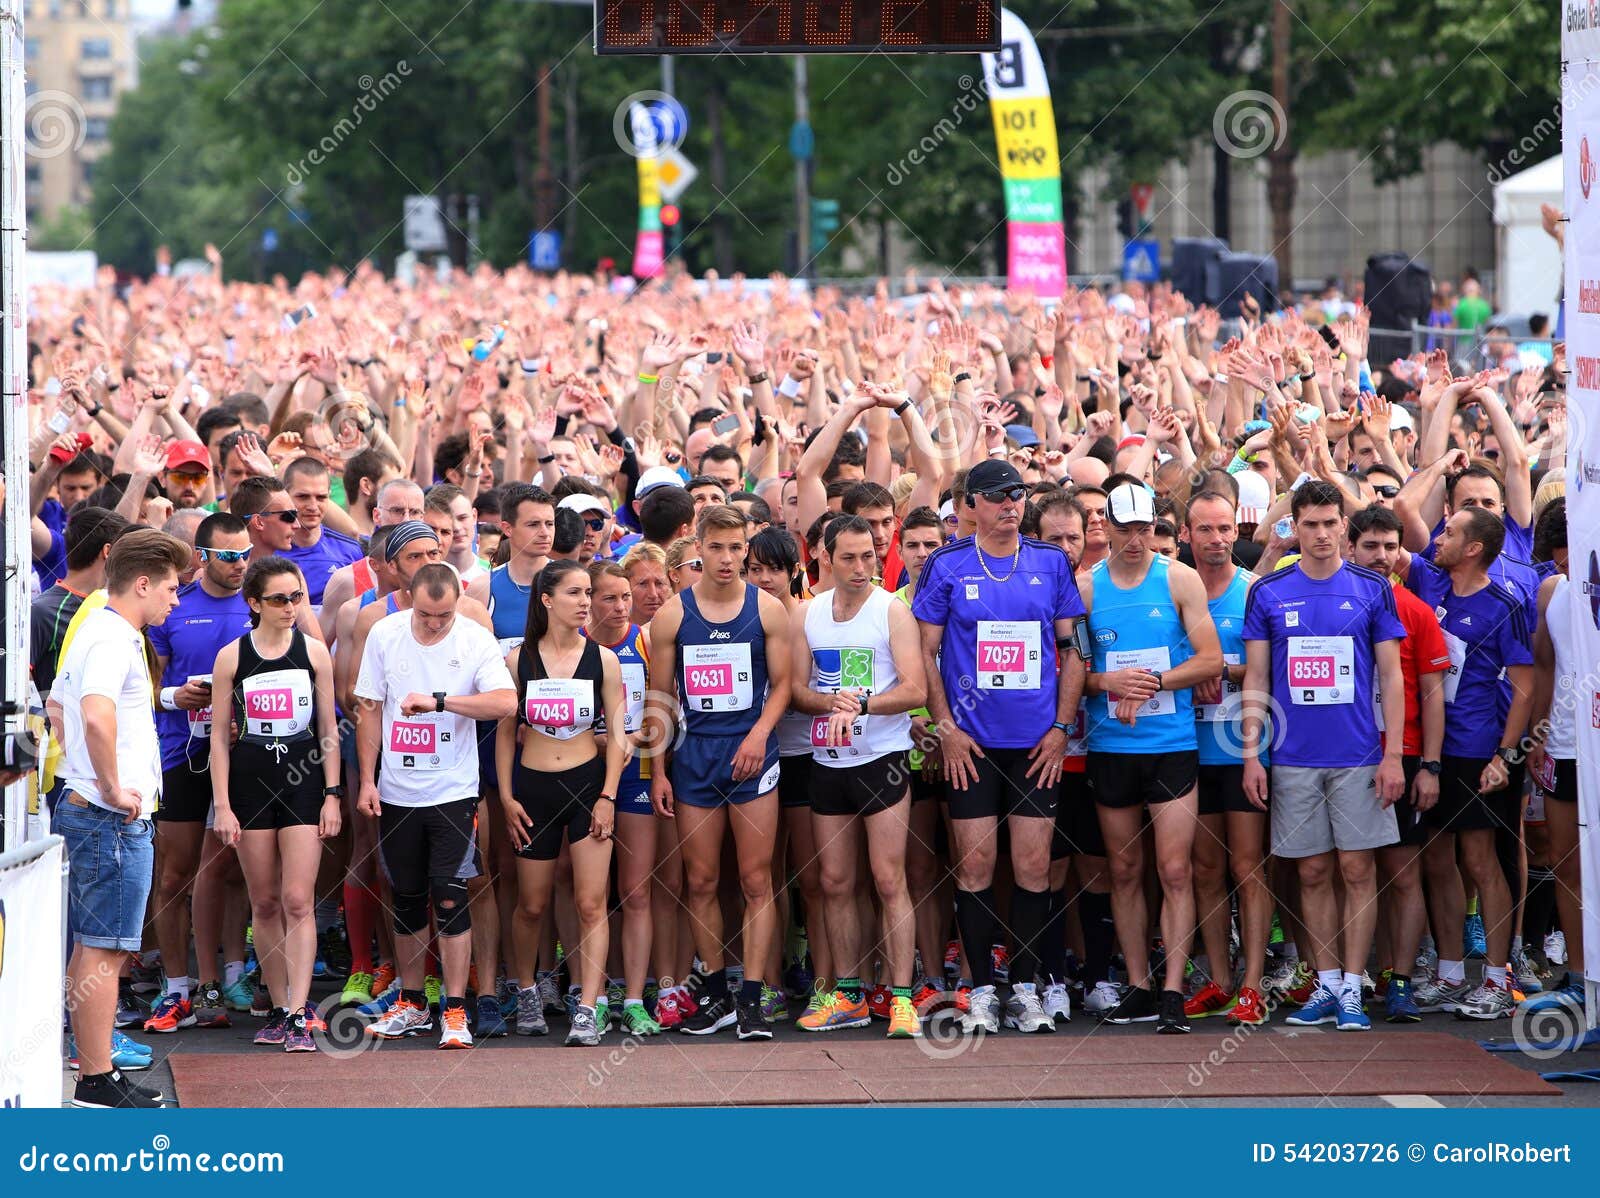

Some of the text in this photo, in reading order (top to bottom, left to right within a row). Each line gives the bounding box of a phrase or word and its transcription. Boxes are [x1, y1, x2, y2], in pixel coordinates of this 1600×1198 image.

[984, 646, 1020, 664] 7057
[691, 669, 725, 688] 9631
[1294, 661, 1330, 679] 8558
[252, 693, 287, 712] 9812
[532, 703, 570, 721] 7043
[395, 726, 431, 746] 7050
